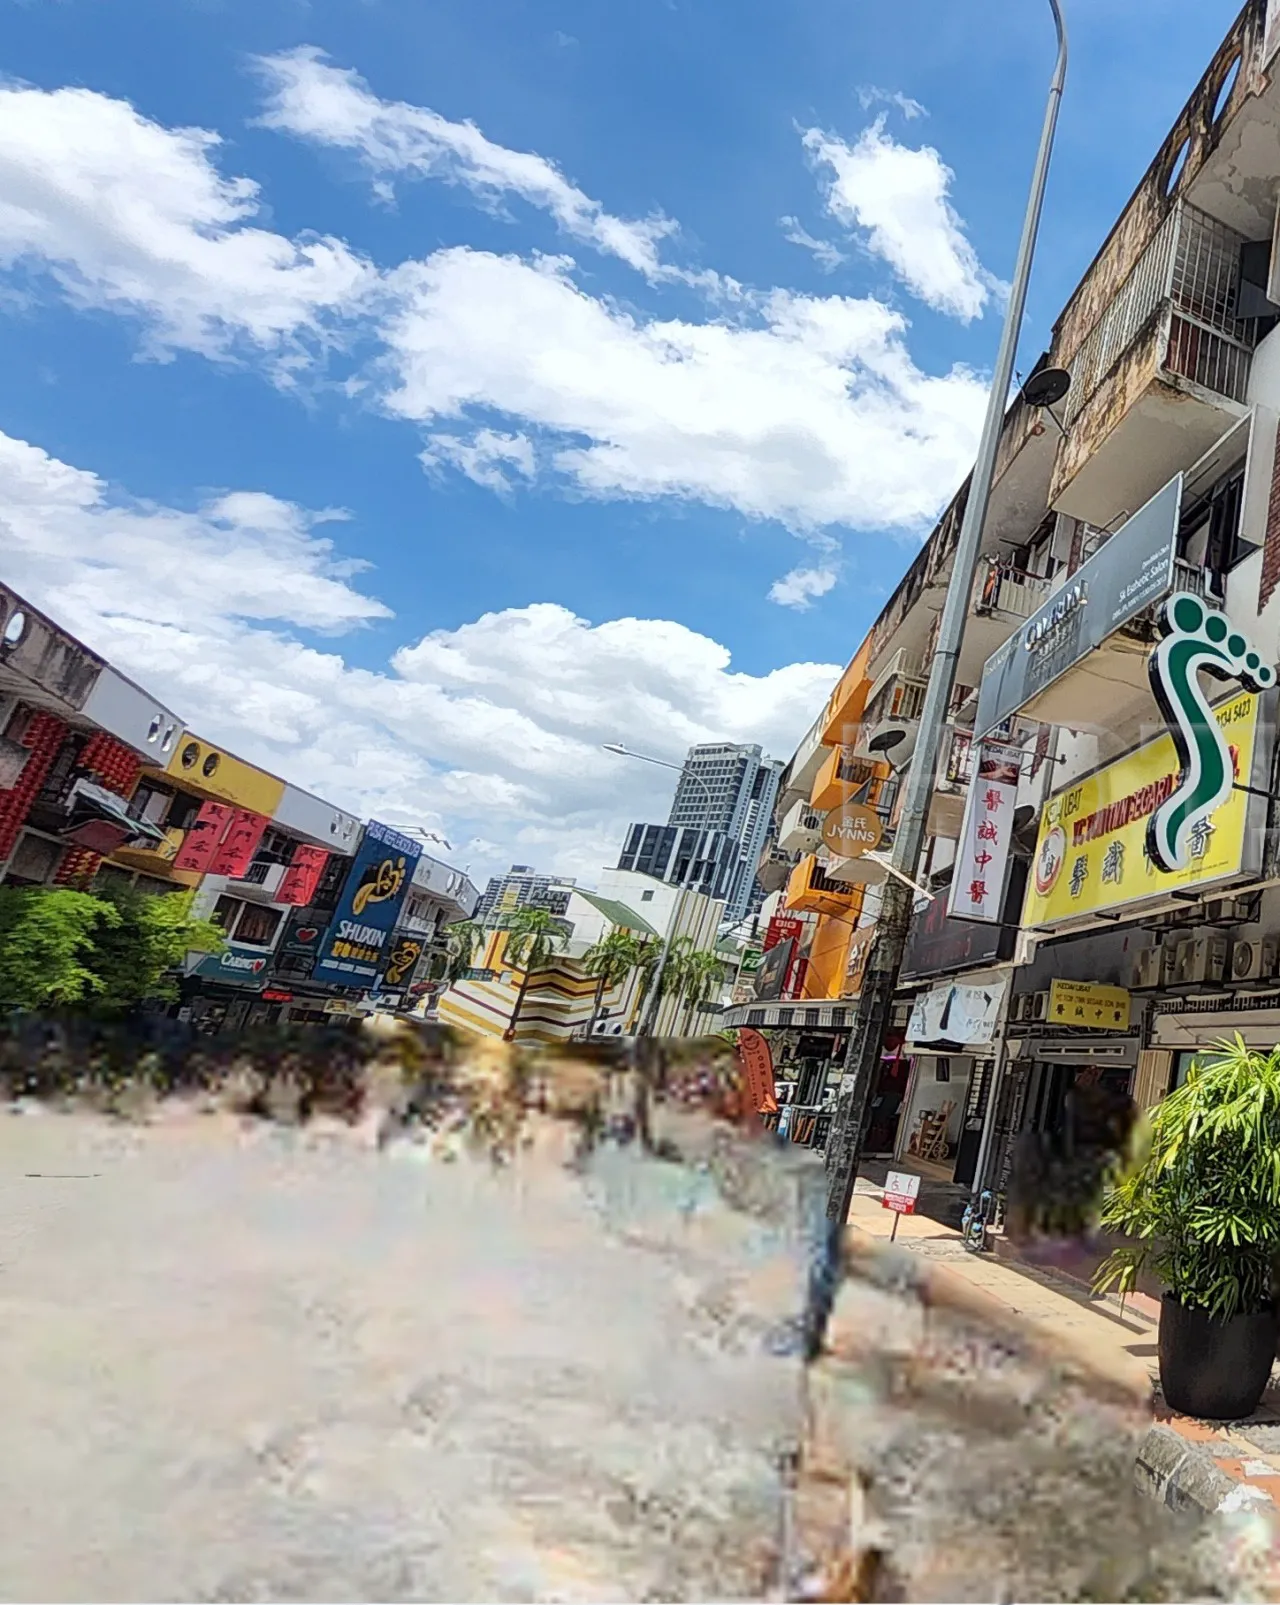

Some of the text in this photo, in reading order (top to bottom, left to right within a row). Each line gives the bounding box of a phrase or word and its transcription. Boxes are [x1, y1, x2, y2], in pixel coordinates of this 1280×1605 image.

[1233, 697, 1252, 723] 5423
[827, 823, 876, 843] JYNNS
[842, 816, 868, 829] 金氏
[966, 788, 1005, 905] 醫誠中醫
[335, 919, 387, 948] SHUXIN
